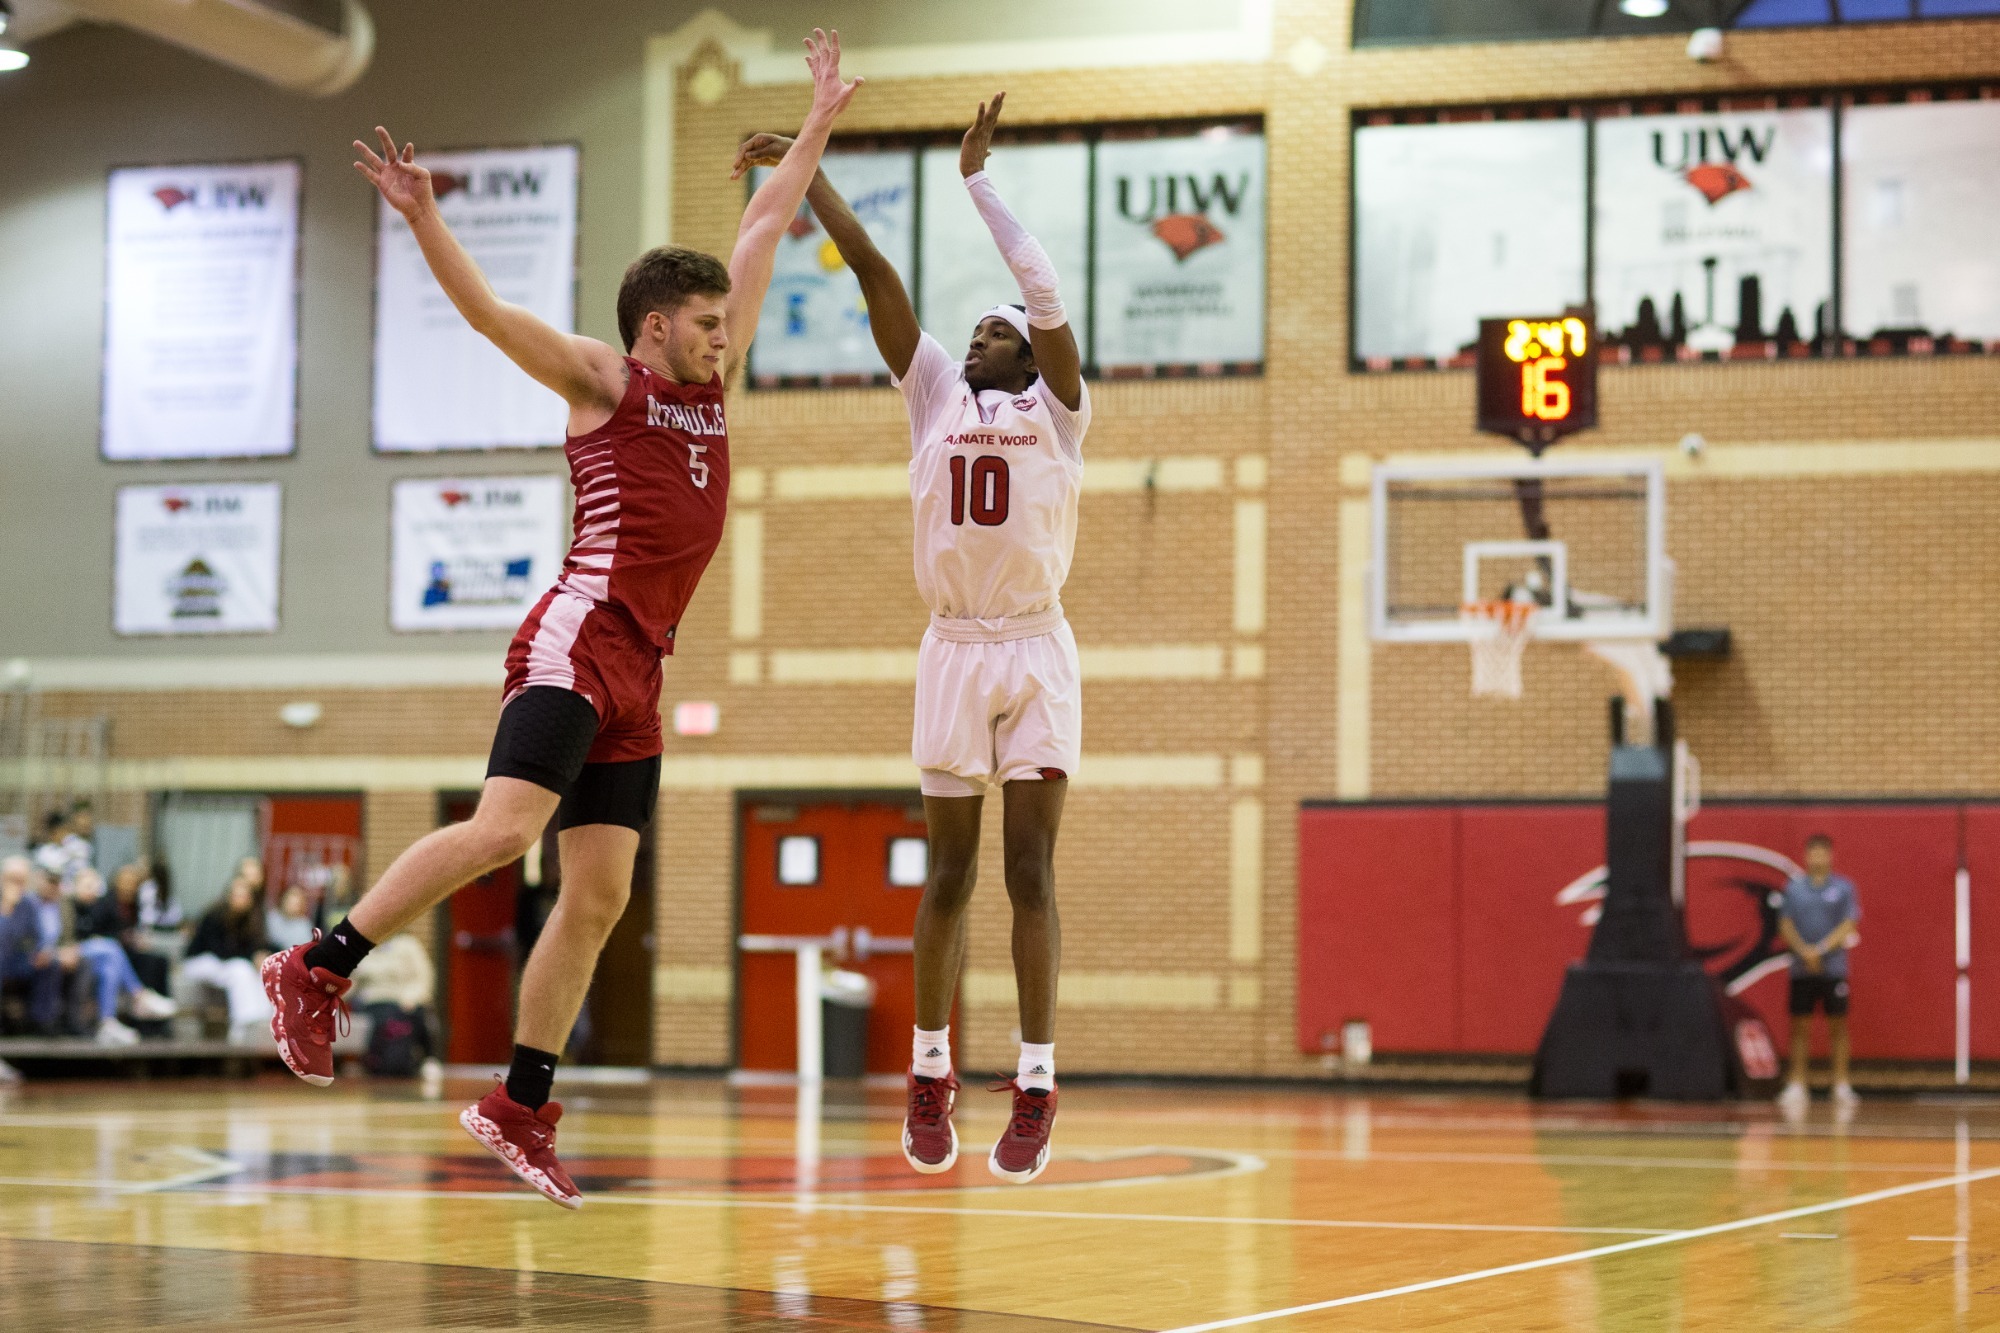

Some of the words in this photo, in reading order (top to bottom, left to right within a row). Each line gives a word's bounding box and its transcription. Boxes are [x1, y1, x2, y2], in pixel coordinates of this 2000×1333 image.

[1651, 127, 1775, 172] UIW
[1118, 173, 1250, 224] UIW
[1522, 356, 1571, 420] 16
[999, 435, 1037, 446] WORD
[687, 443, 709, 489] 5
[949, 455, 1009, 526] 10
